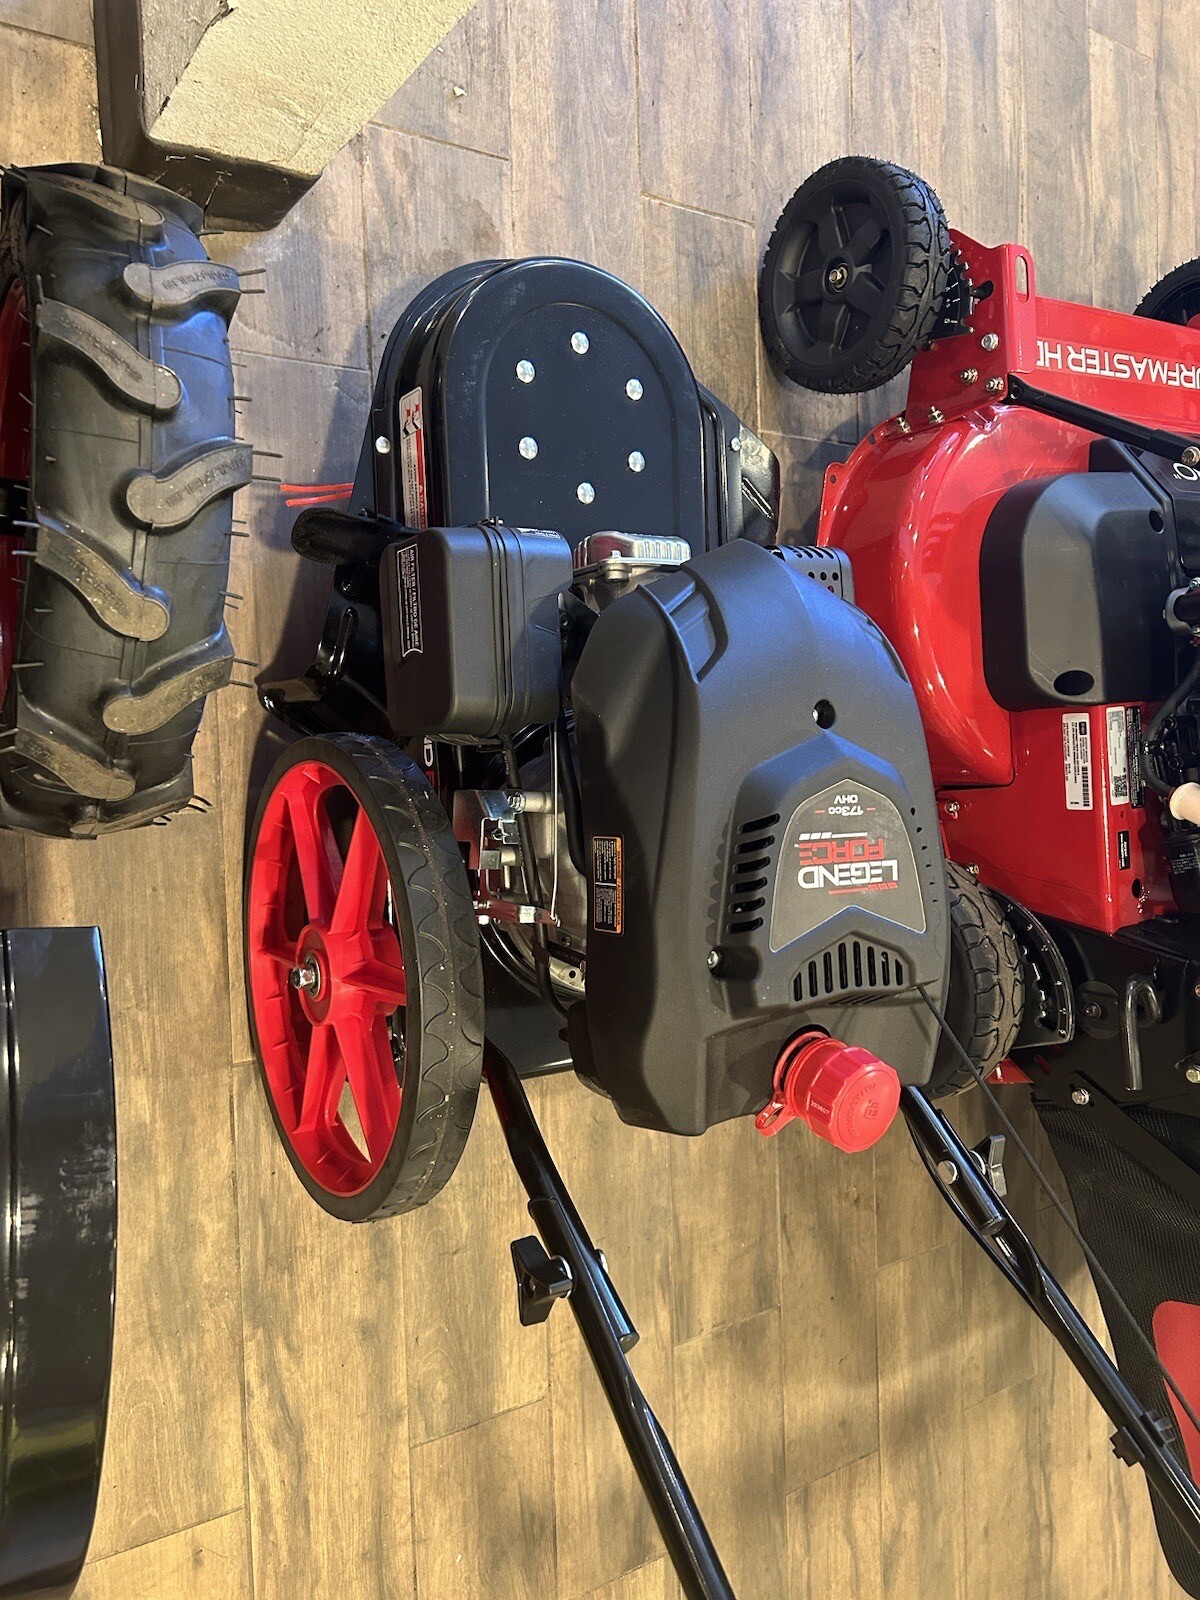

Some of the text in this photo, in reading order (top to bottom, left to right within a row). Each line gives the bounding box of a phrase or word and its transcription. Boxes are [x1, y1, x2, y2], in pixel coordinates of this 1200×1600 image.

[1067, 345, 1200, 389] RFMASTER
[827, 805, 864, 816] 173cc
[834, 794, 859, 804] OHV
[799, 838, 885, 866] FORCE
[797, 859, 898, 889] LEGEND
